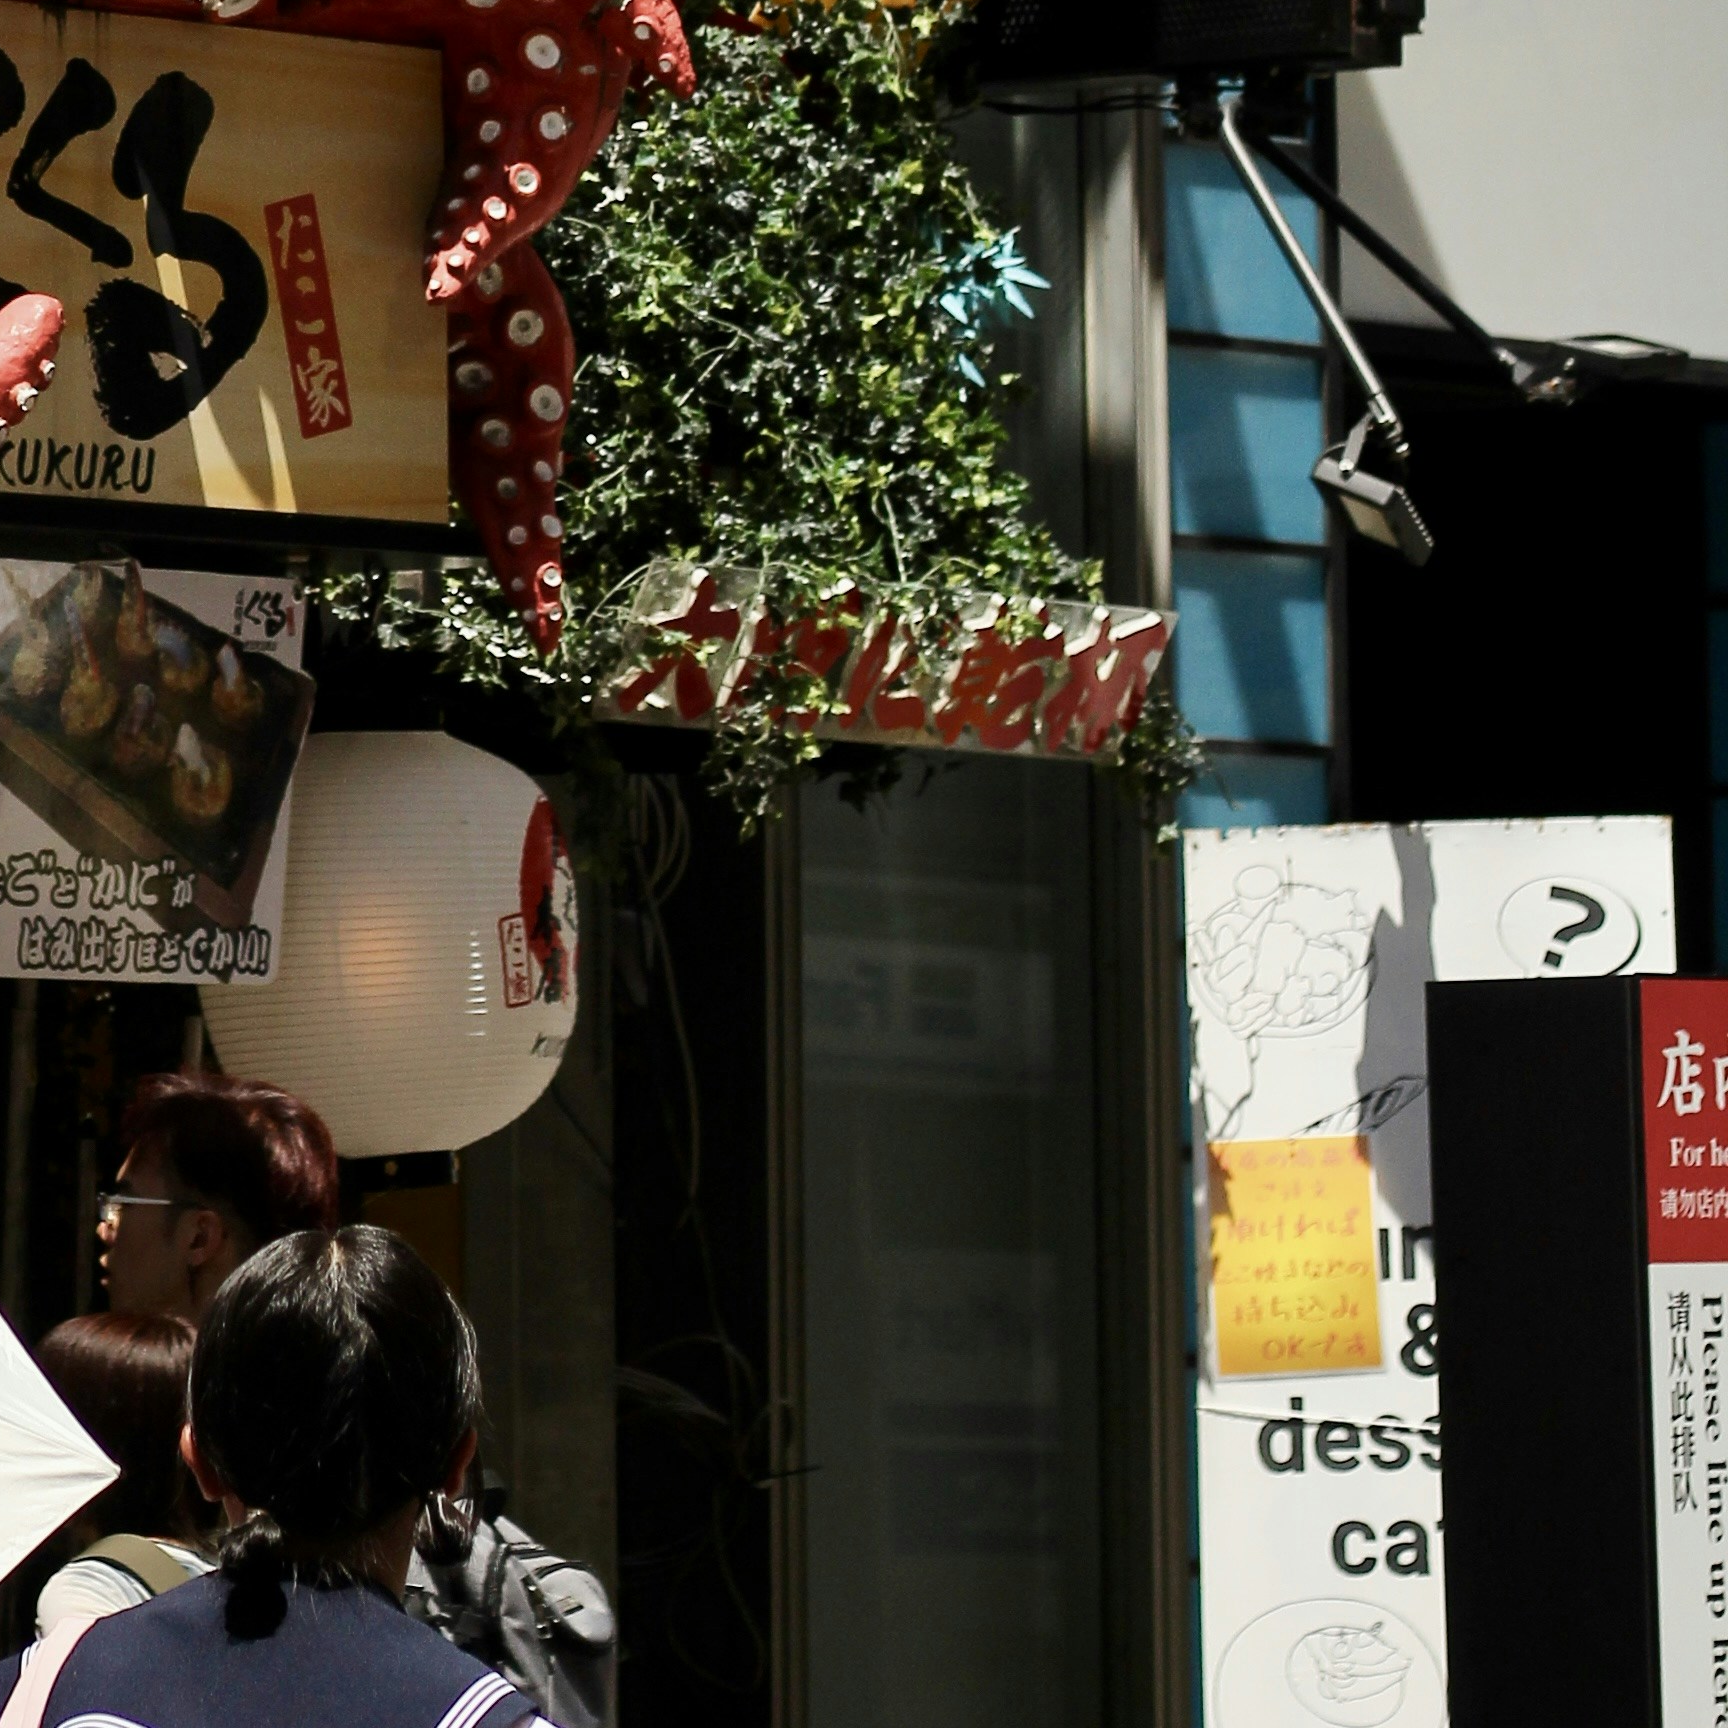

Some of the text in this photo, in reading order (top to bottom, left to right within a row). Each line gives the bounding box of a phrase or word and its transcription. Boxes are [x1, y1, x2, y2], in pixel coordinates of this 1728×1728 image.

[273, 207, 347, 431] たこ家
[1669, 1135, 1707, 1168] For
[1700, 1293, 1724, 1445] Please
